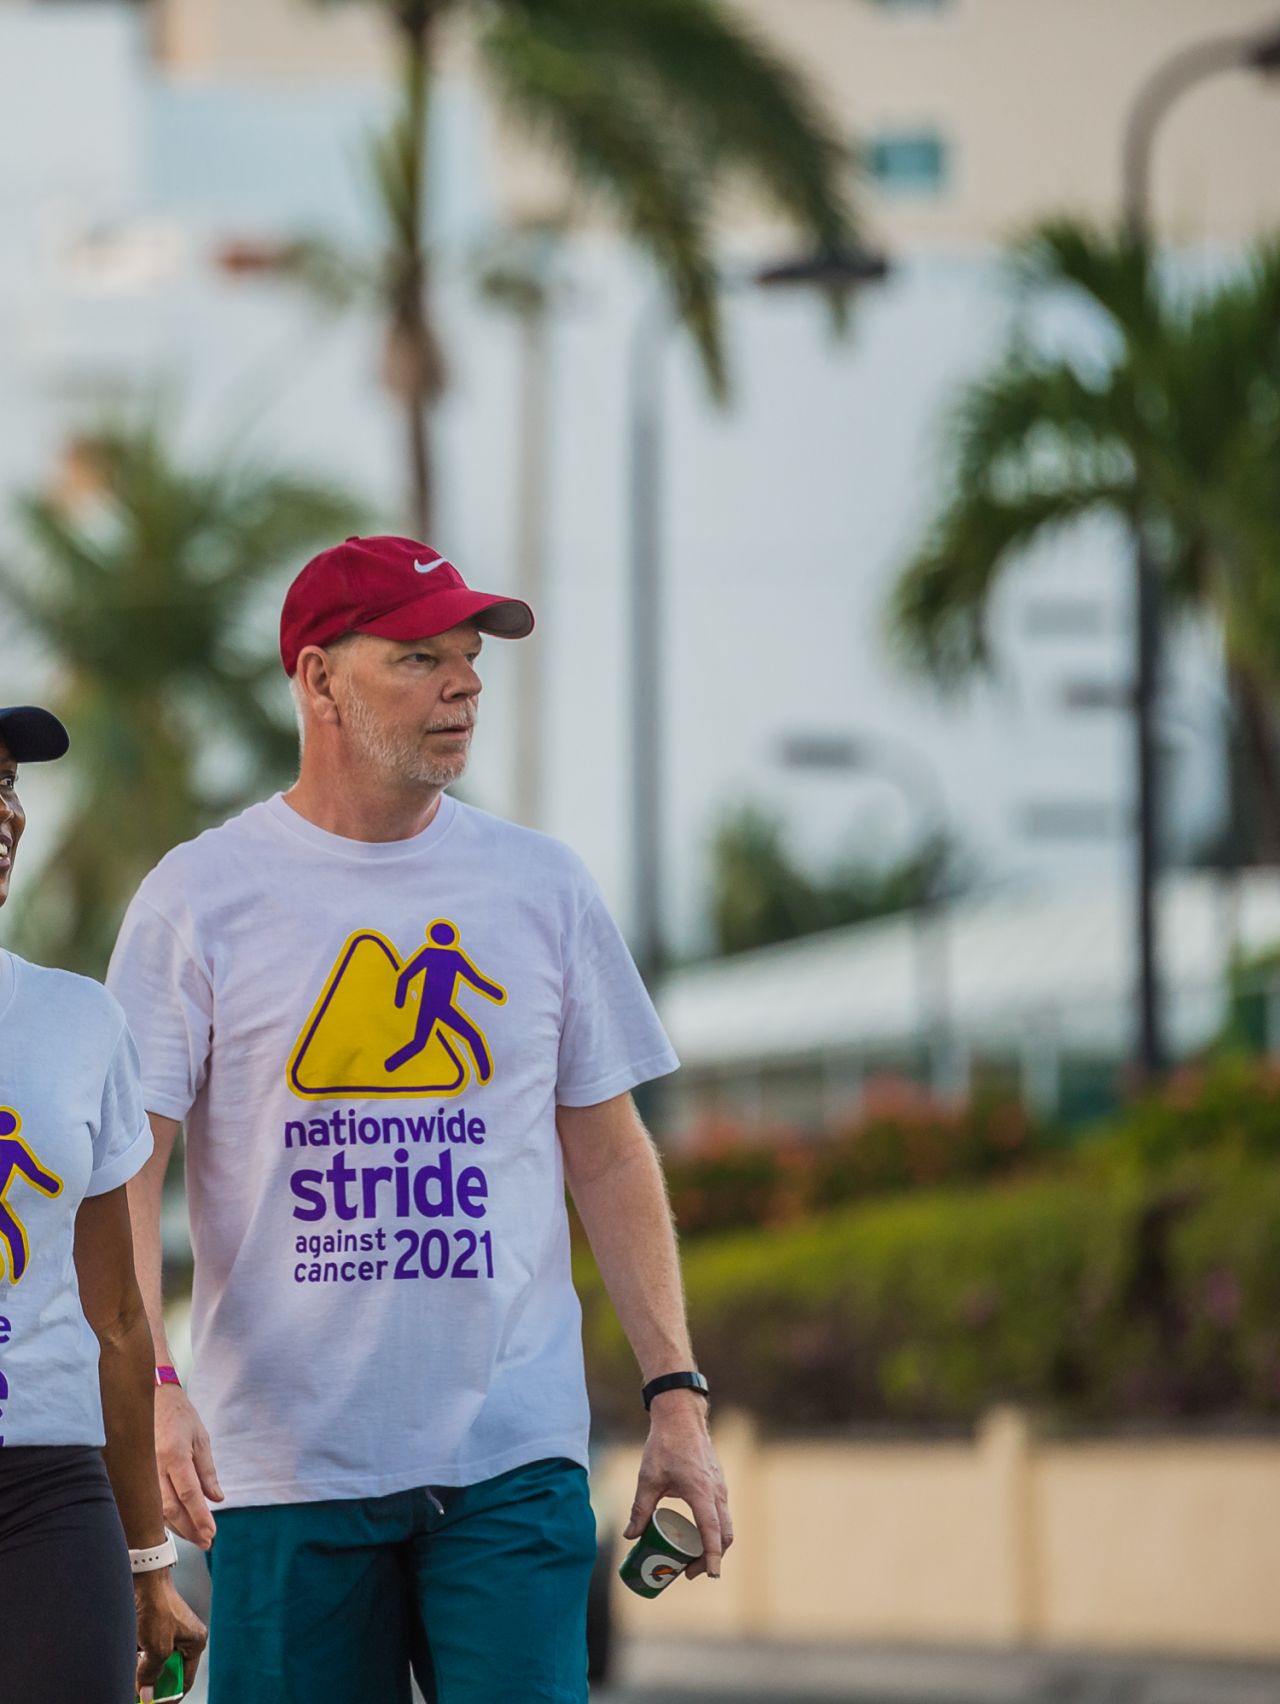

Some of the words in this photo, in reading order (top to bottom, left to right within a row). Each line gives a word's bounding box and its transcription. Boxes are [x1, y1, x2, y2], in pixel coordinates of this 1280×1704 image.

[284, 1107, 487, 1149] nationwide
[289, 1147, 489, 1222] stride
[295, 1227, 387, 1259] against
[393, 1228, 495, 1280] 2021
[293, 1259, 389, 1283] cancer
